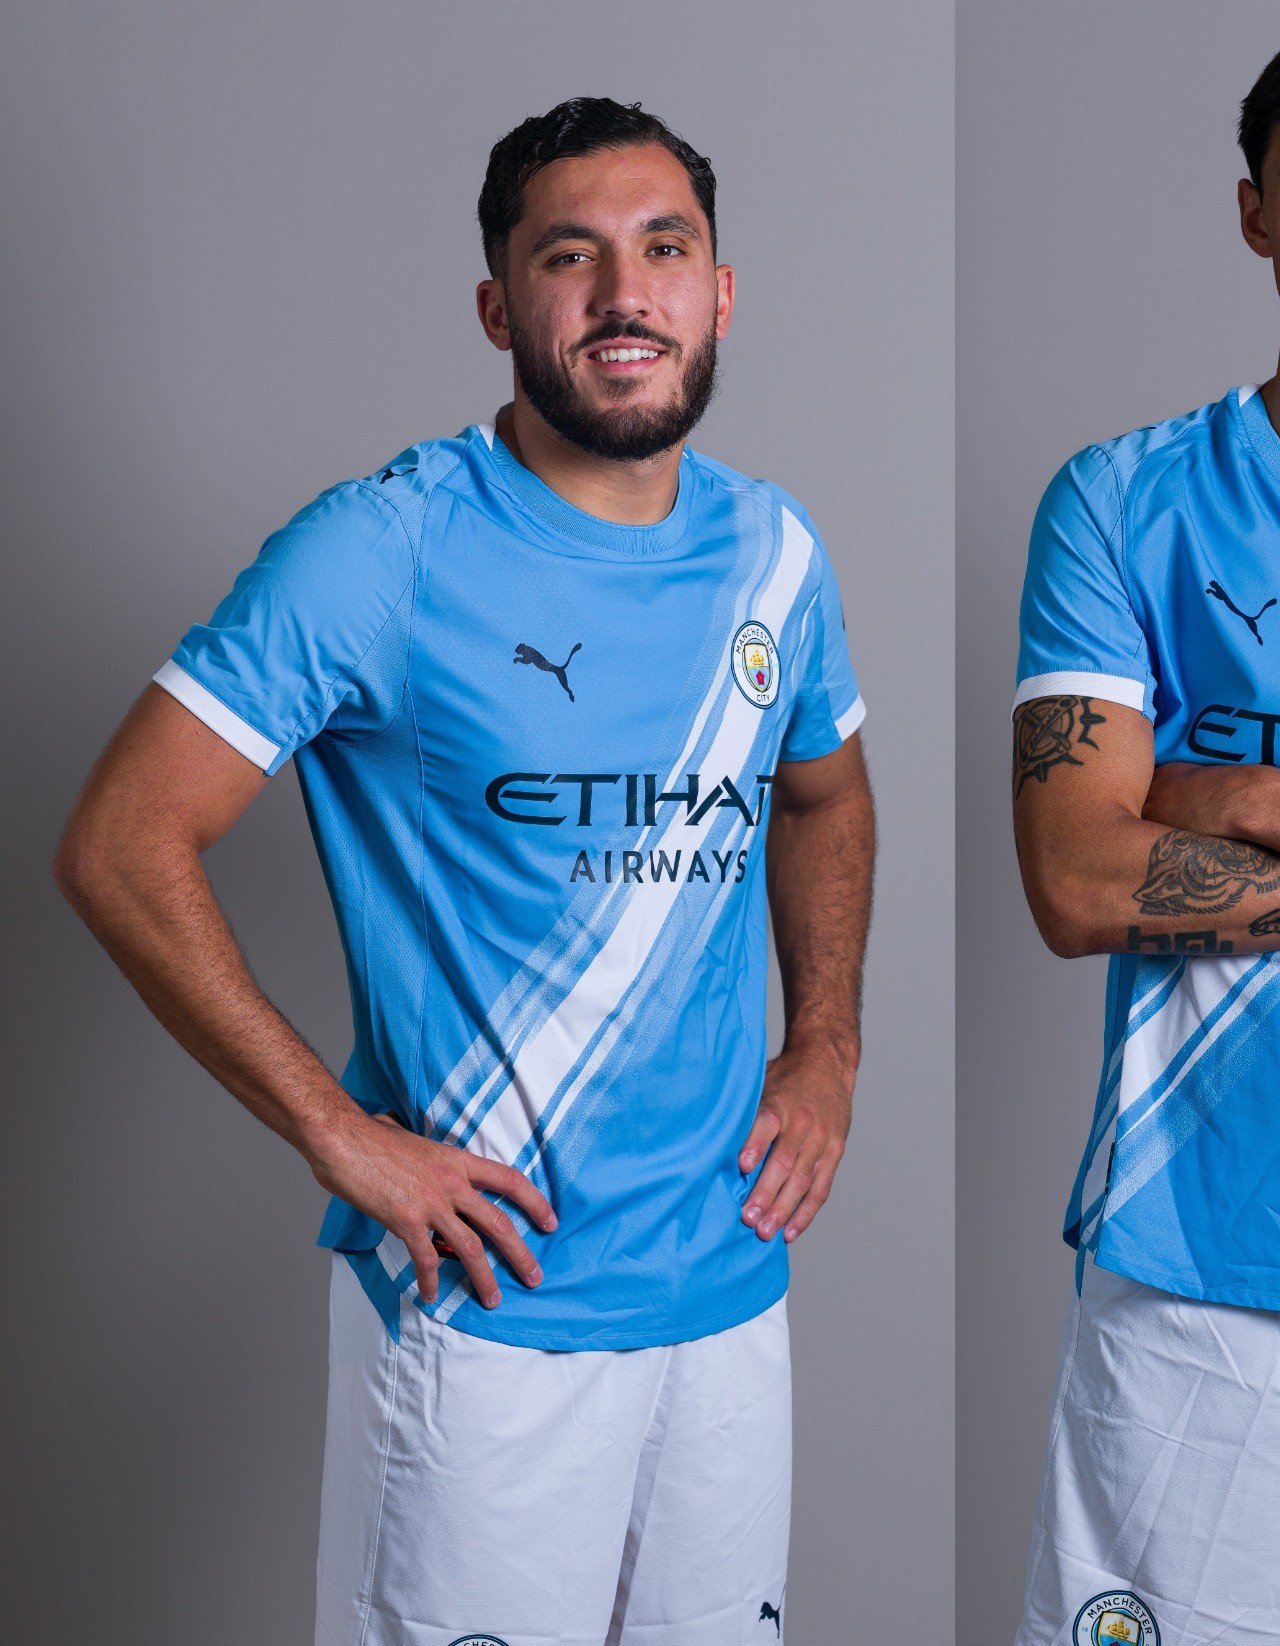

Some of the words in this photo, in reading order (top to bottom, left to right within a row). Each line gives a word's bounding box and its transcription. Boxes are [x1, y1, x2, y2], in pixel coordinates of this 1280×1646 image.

[735, 627, 774, 654] MANCHESTER
[756, 693, 770, 702] CITY
[569, 849, 748, 884] AIRWAYS
[1087, 1597, 1153, 1634] MANCHESTER
